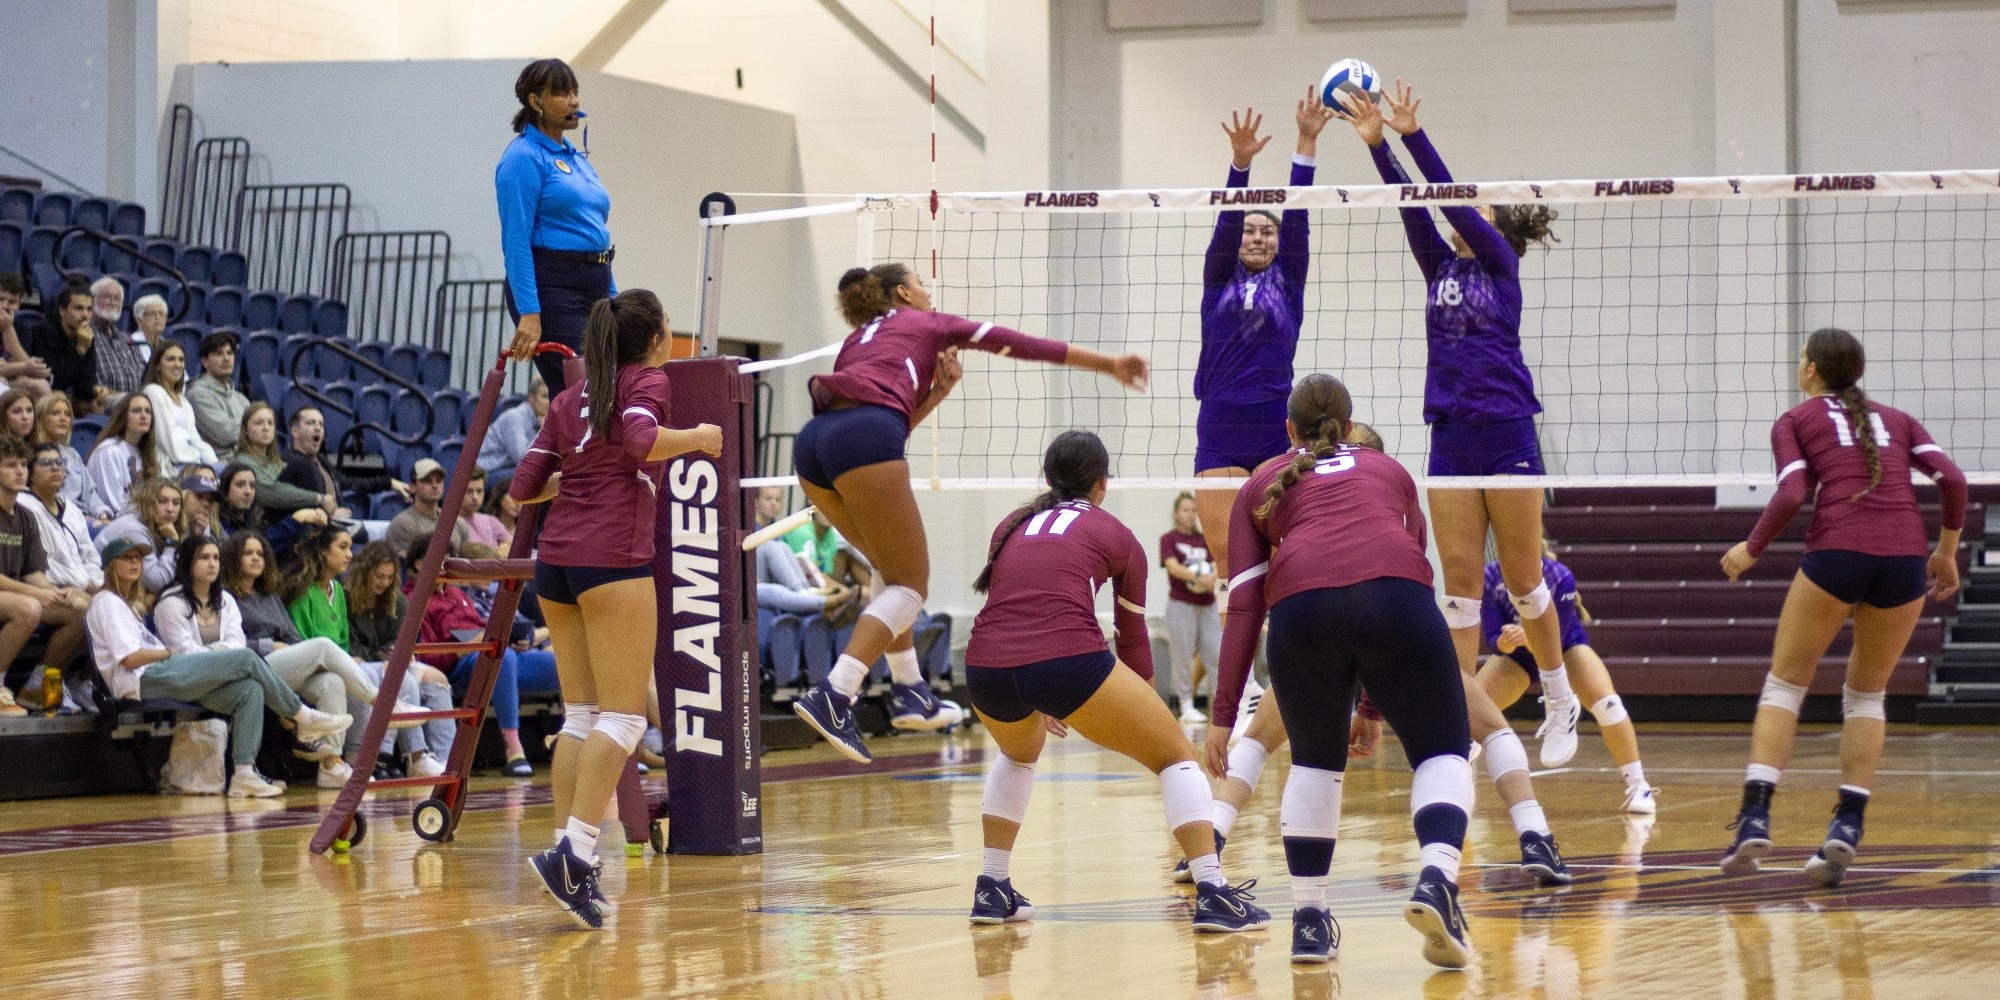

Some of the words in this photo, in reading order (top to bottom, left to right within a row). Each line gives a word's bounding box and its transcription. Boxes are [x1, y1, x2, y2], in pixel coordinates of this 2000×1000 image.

[1400, 185, 1478, 200] FLAMES
[1594, 179, 1675, 196] FLAMES
[1794, 174, 1876, 191] FLAMES
[1024, 192, 1099, 207] FLAMES
[1209, 189, 1287, 205] FLAMES
[1436, 278, 1463, 306] 18
[1828, 411, 1891, 447] 14
[1024, 508, 1081, 535] 11
[669, 458, 723, 756] FLAMES
[742, 651, 750, 703] sports
[743, 706, 752, 769] imports
[742, 797, 757, 811] LEE
